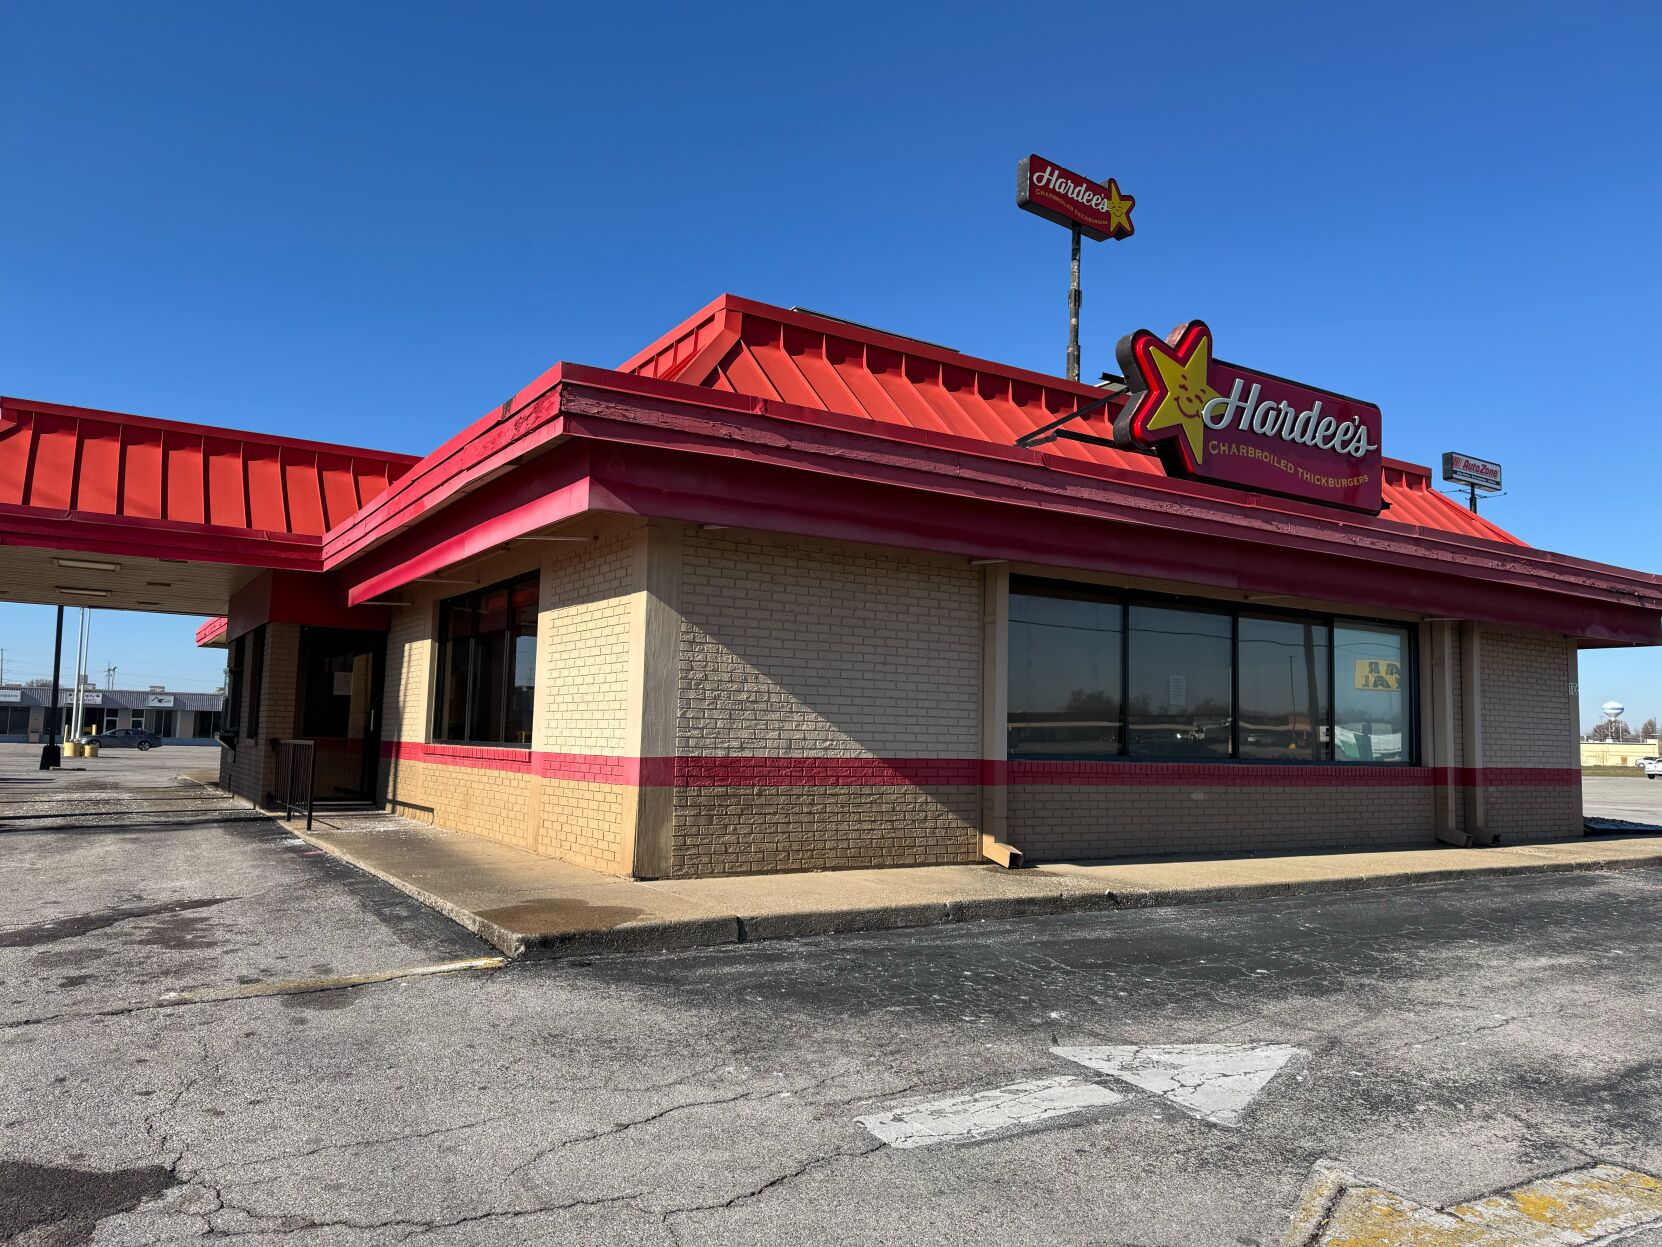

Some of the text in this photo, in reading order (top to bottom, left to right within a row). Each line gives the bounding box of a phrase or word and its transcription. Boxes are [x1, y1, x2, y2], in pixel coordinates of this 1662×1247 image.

[1033, 166, 1112, 212] Hardee's
[1201, 378, 1378, 458] Hardee's
[1208, 440, 1369, 488] CHARBROILED THICKBURGERS
[1462, 459, 1499, 479] AutoZone
